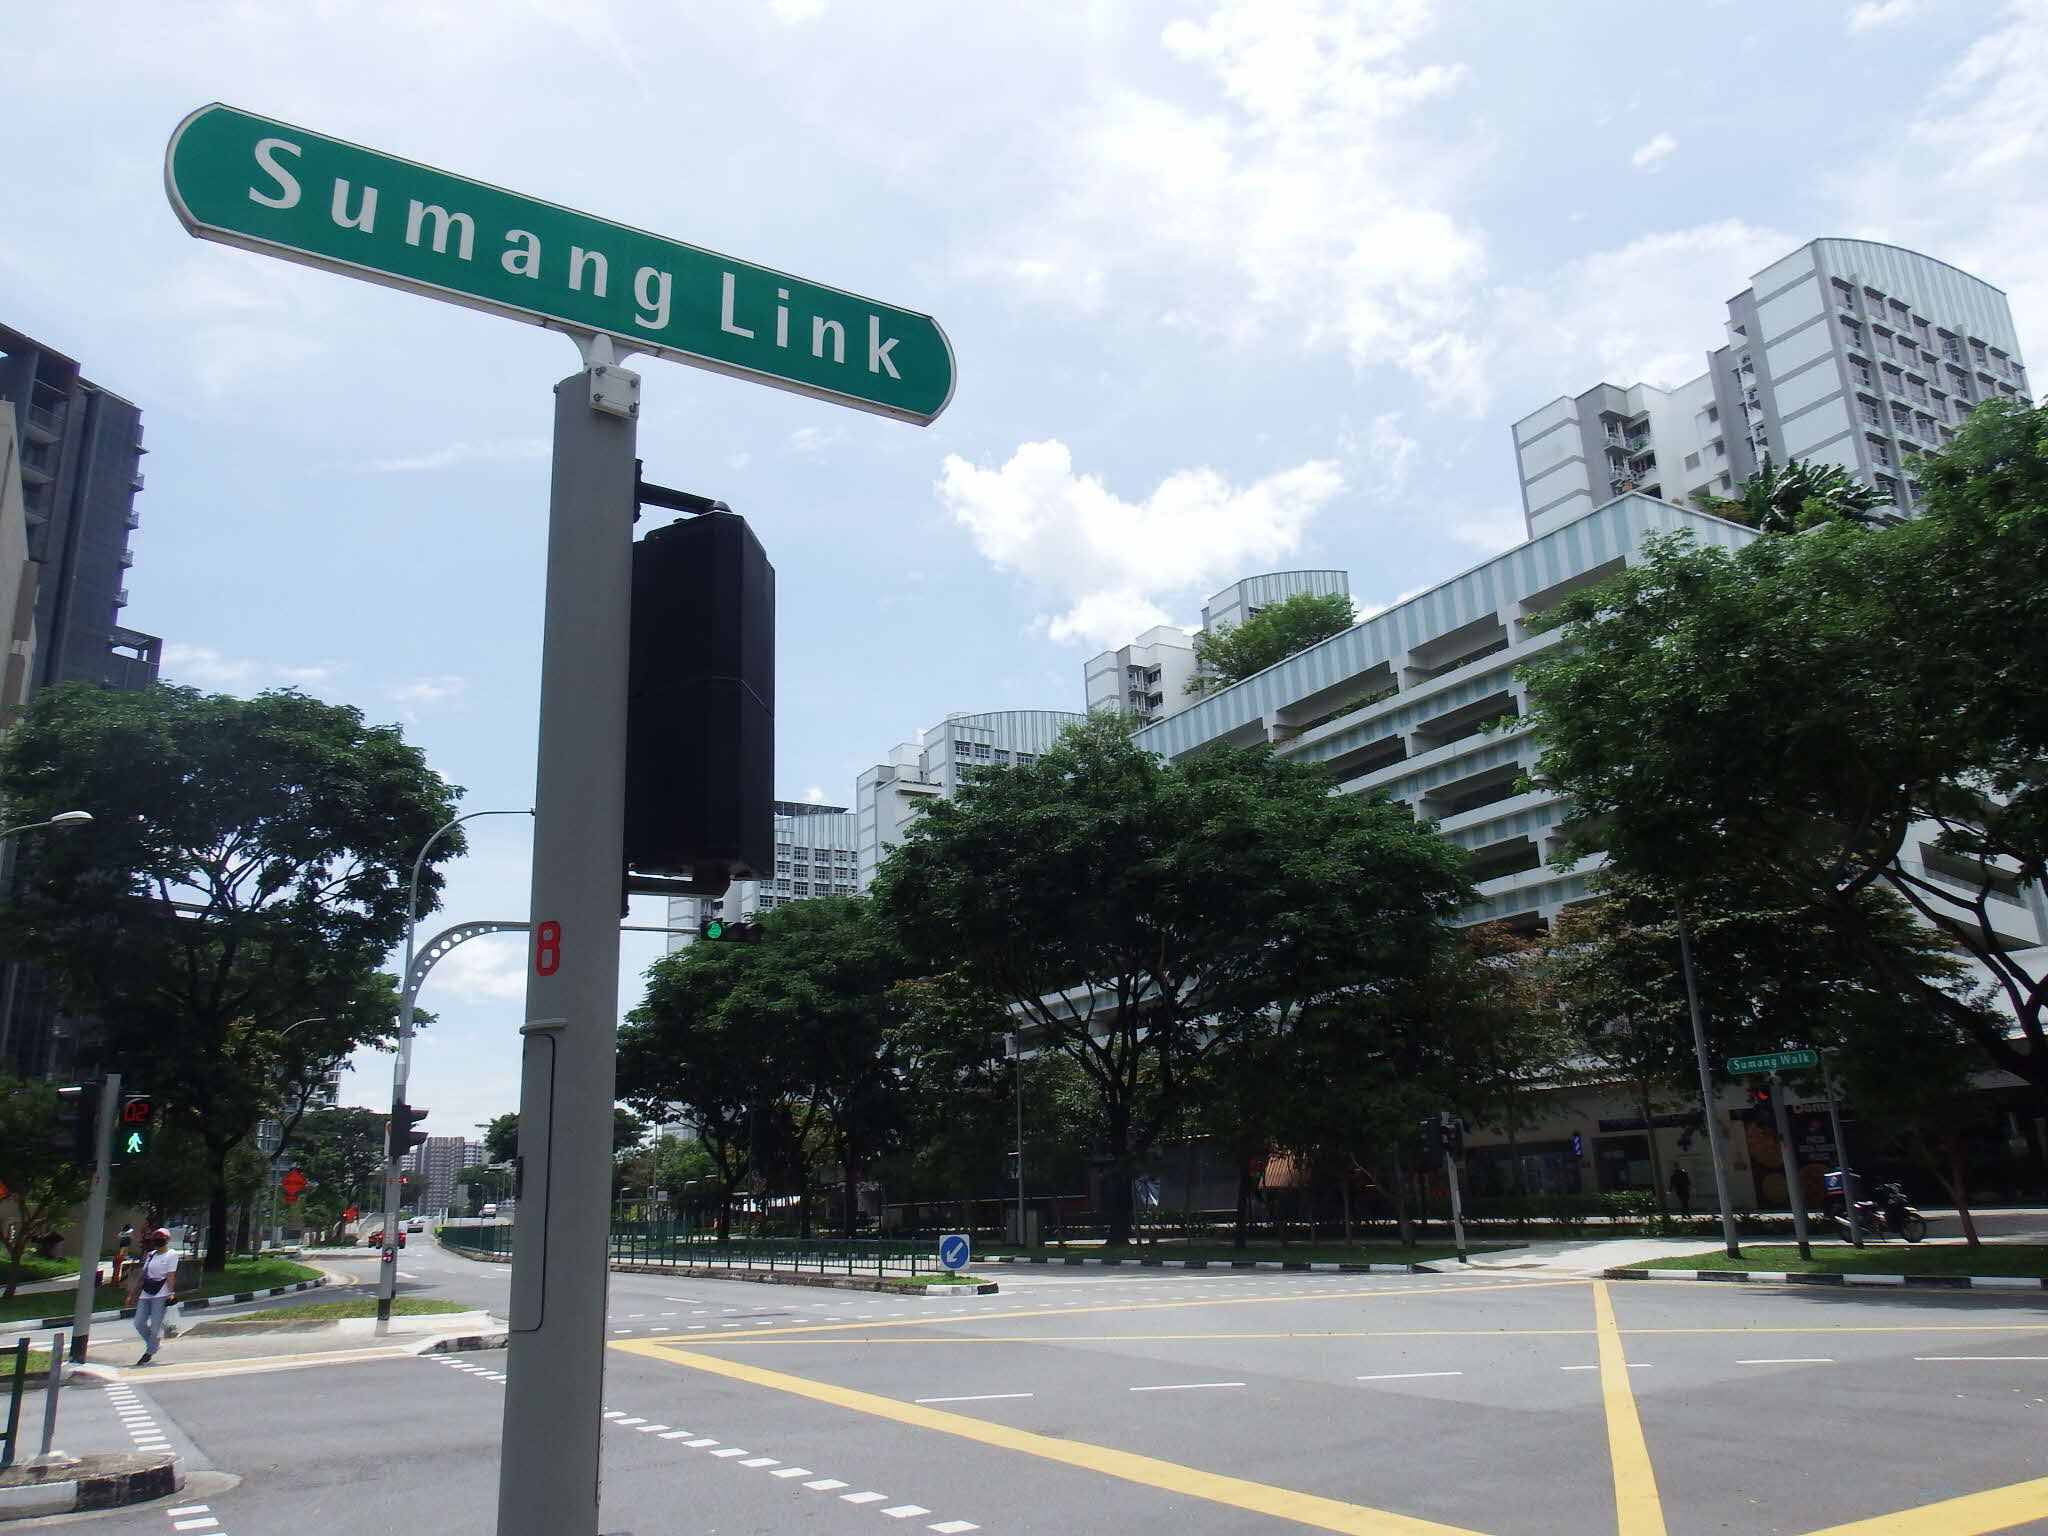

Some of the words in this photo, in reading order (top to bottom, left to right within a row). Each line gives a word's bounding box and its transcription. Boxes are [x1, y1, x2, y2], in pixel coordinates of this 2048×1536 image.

[248, 137, 674, 331] Sumang
[720, 271, 902, 380] Link
[536, 920, 560, 976] 8
[1733, 1058, 1777, 1070] Sumang
[1780, 1053, 1811, 1065] Walk
